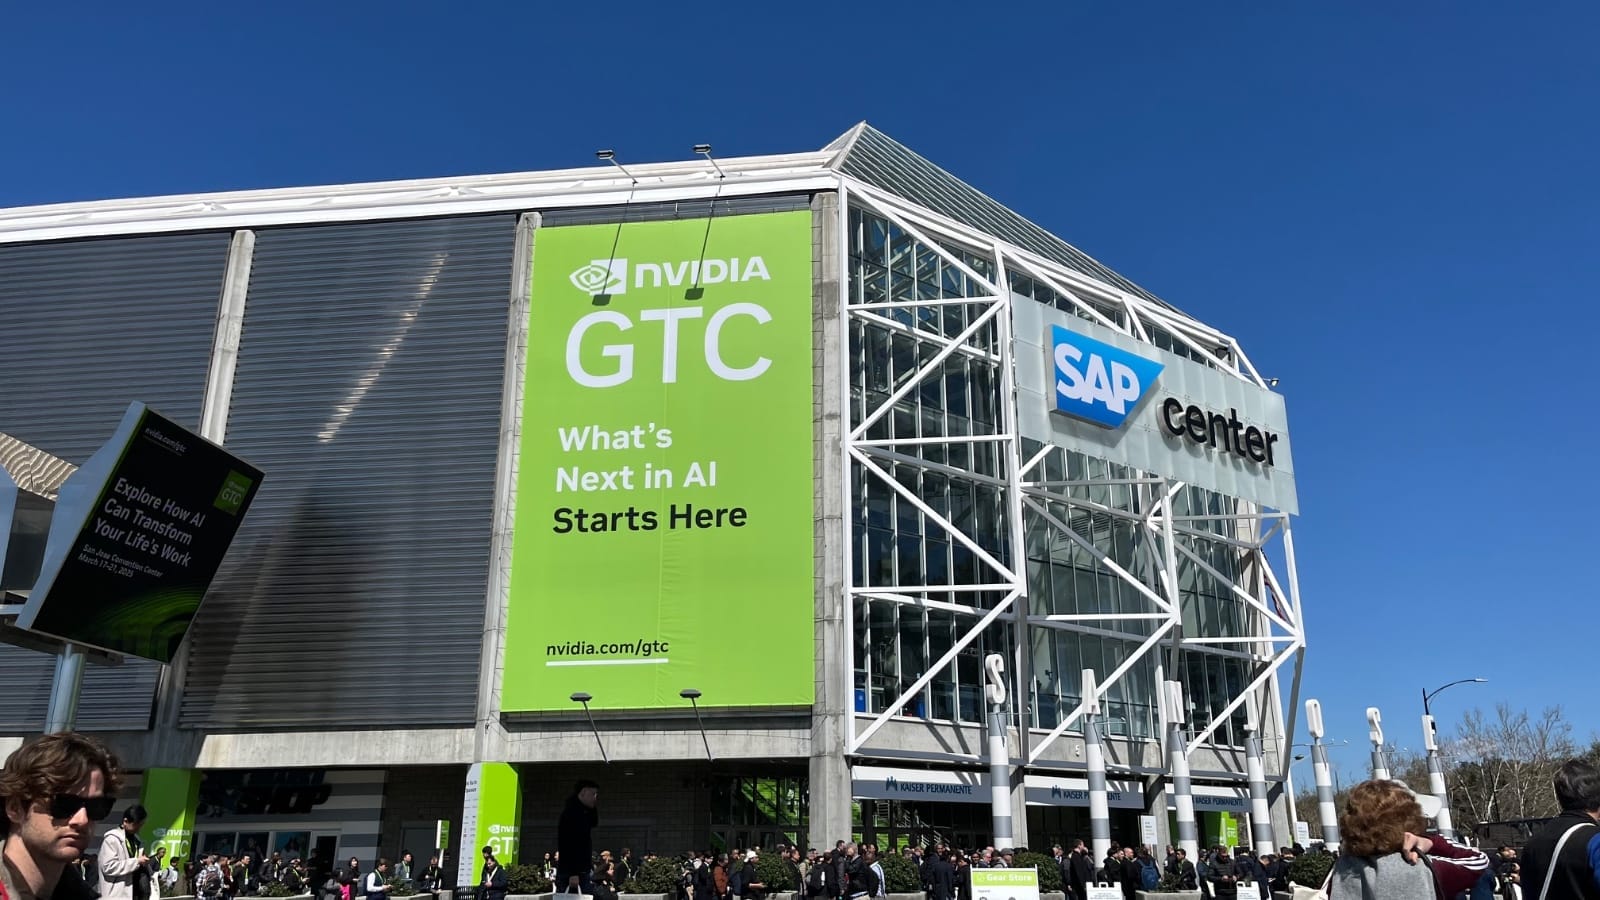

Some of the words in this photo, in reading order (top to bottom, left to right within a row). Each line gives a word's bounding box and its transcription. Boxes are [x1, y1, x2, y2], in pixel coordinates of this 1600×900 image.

[566, 302, 773, 388] GTC
[1054, 343, 1140, 415] SAP
[144, 427, 187, 453] nvidia.com/gtc
[558, 423, 673, 451] What's
[1162, 398, 1278, 467] center
[556, 466, 634, 492] Next
[644, 463, 673, 489] in
[683, 461, 717, 487] AI
[114, 477, 162, 510] Explore
[162, 499, 188, 521] How
[190, 513, 206, 528] AI
[221, 488, 242, 505] GTC
[104, 498, 130, 521] Can
[133, 509, 193, 546] Transform
[553, 506, 658, 534] Starts
[669, 504, 748, 529] Here
[94, 518, 124, 542] Your
[125, 530, 159, 555] Life's
[160, 543, 192, 567] Work
[78, 553, 99, 567] March
[118, 566, 134, 578] 2025
[83, 543, 96, 554] San
[96, 548, 110, 560] Jose
[111, 553, 144, 571] Convention
[143, 565, 164, 578] Center
[546, 639, 669, 656] nvidia.com/gtc
[900, 783, 924, 793] KAISER
[926, 784, 972, 795] PERMANENTE
[1063, 790, 1083, 800] KAISER
[986, 873, 1007, 881] Gear
[1008, 873, 1033, 881] Store
